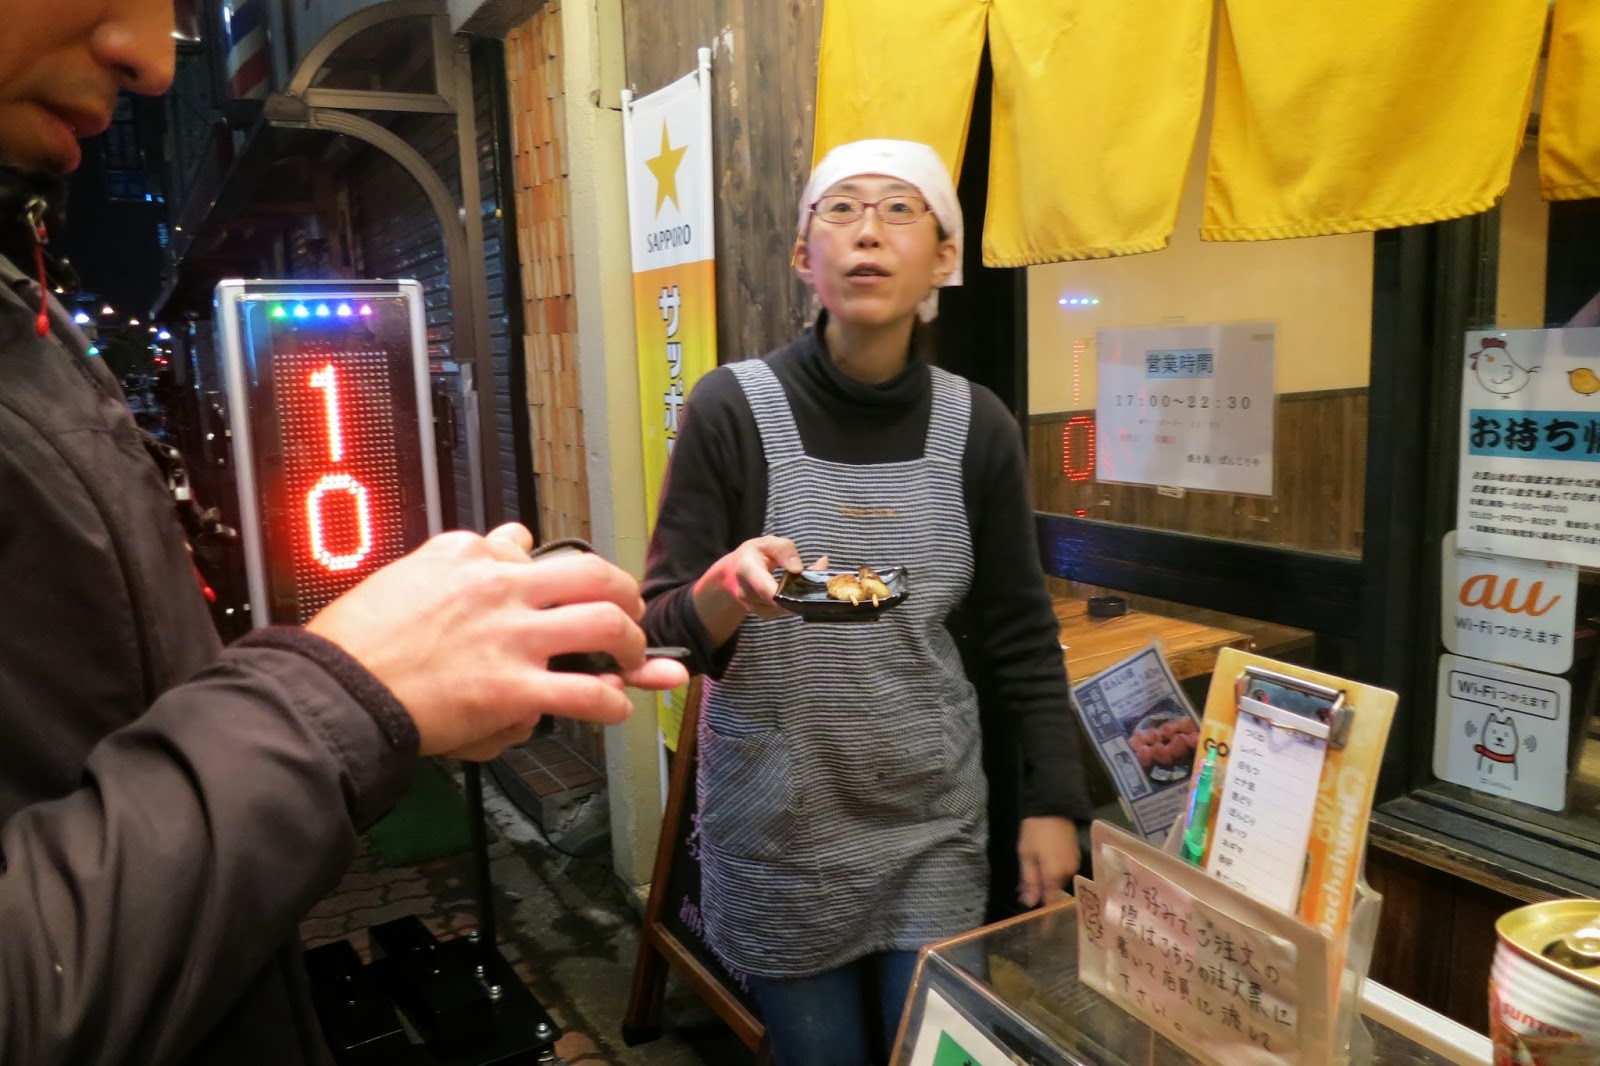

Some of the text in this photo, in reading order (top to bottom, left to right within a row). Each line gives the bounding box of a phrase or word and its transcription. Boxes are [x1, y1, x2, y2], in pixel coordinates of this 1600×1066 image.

[646, 223, 692, 253] SAPPORO
[658, 285, 685, 455] サッポ
[1146, 353, 1213, 374] 営業時間
[1458, 574, 1562, 617] au
